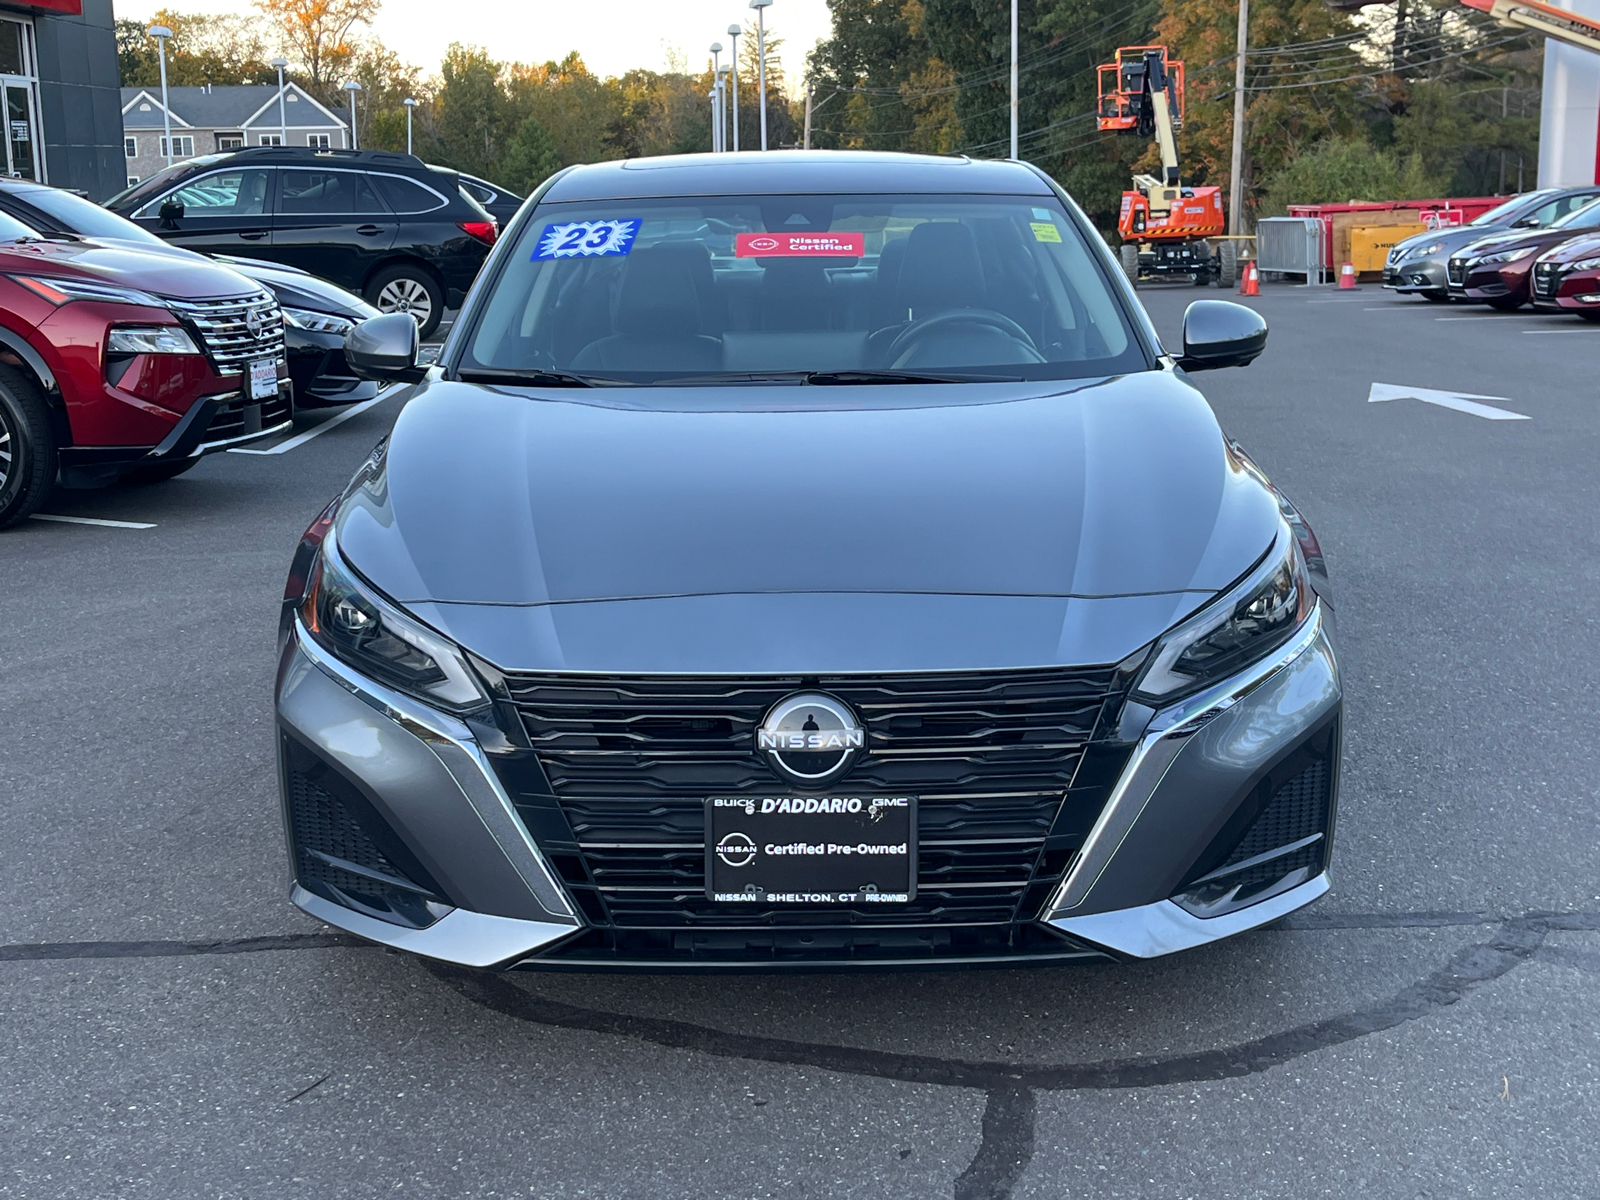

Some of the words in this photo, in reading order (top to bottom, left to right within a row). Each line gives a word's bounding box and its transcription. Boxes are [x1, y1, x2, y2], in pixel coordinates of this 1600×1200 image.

[556, 226, 614, 250] 23
[789, 243, 852, 251] Certified
[761, 733, 862, 748] NISSAN
[714, 799, 756, 807] BUICK
[761, 798, 862, 813] D'ADDARIO
[872, 798, 908, 806] GMC
[764, 843, 824, 855] Certified
[827, 843, 907, 855] Pre-Owned
[714, 893, 757, 902] NISSAN
[766, 893, 834, 902] SHELTON,
[838, 893, 857, 902] CT
[865, 893, 908, 902] PRE-OWNED
